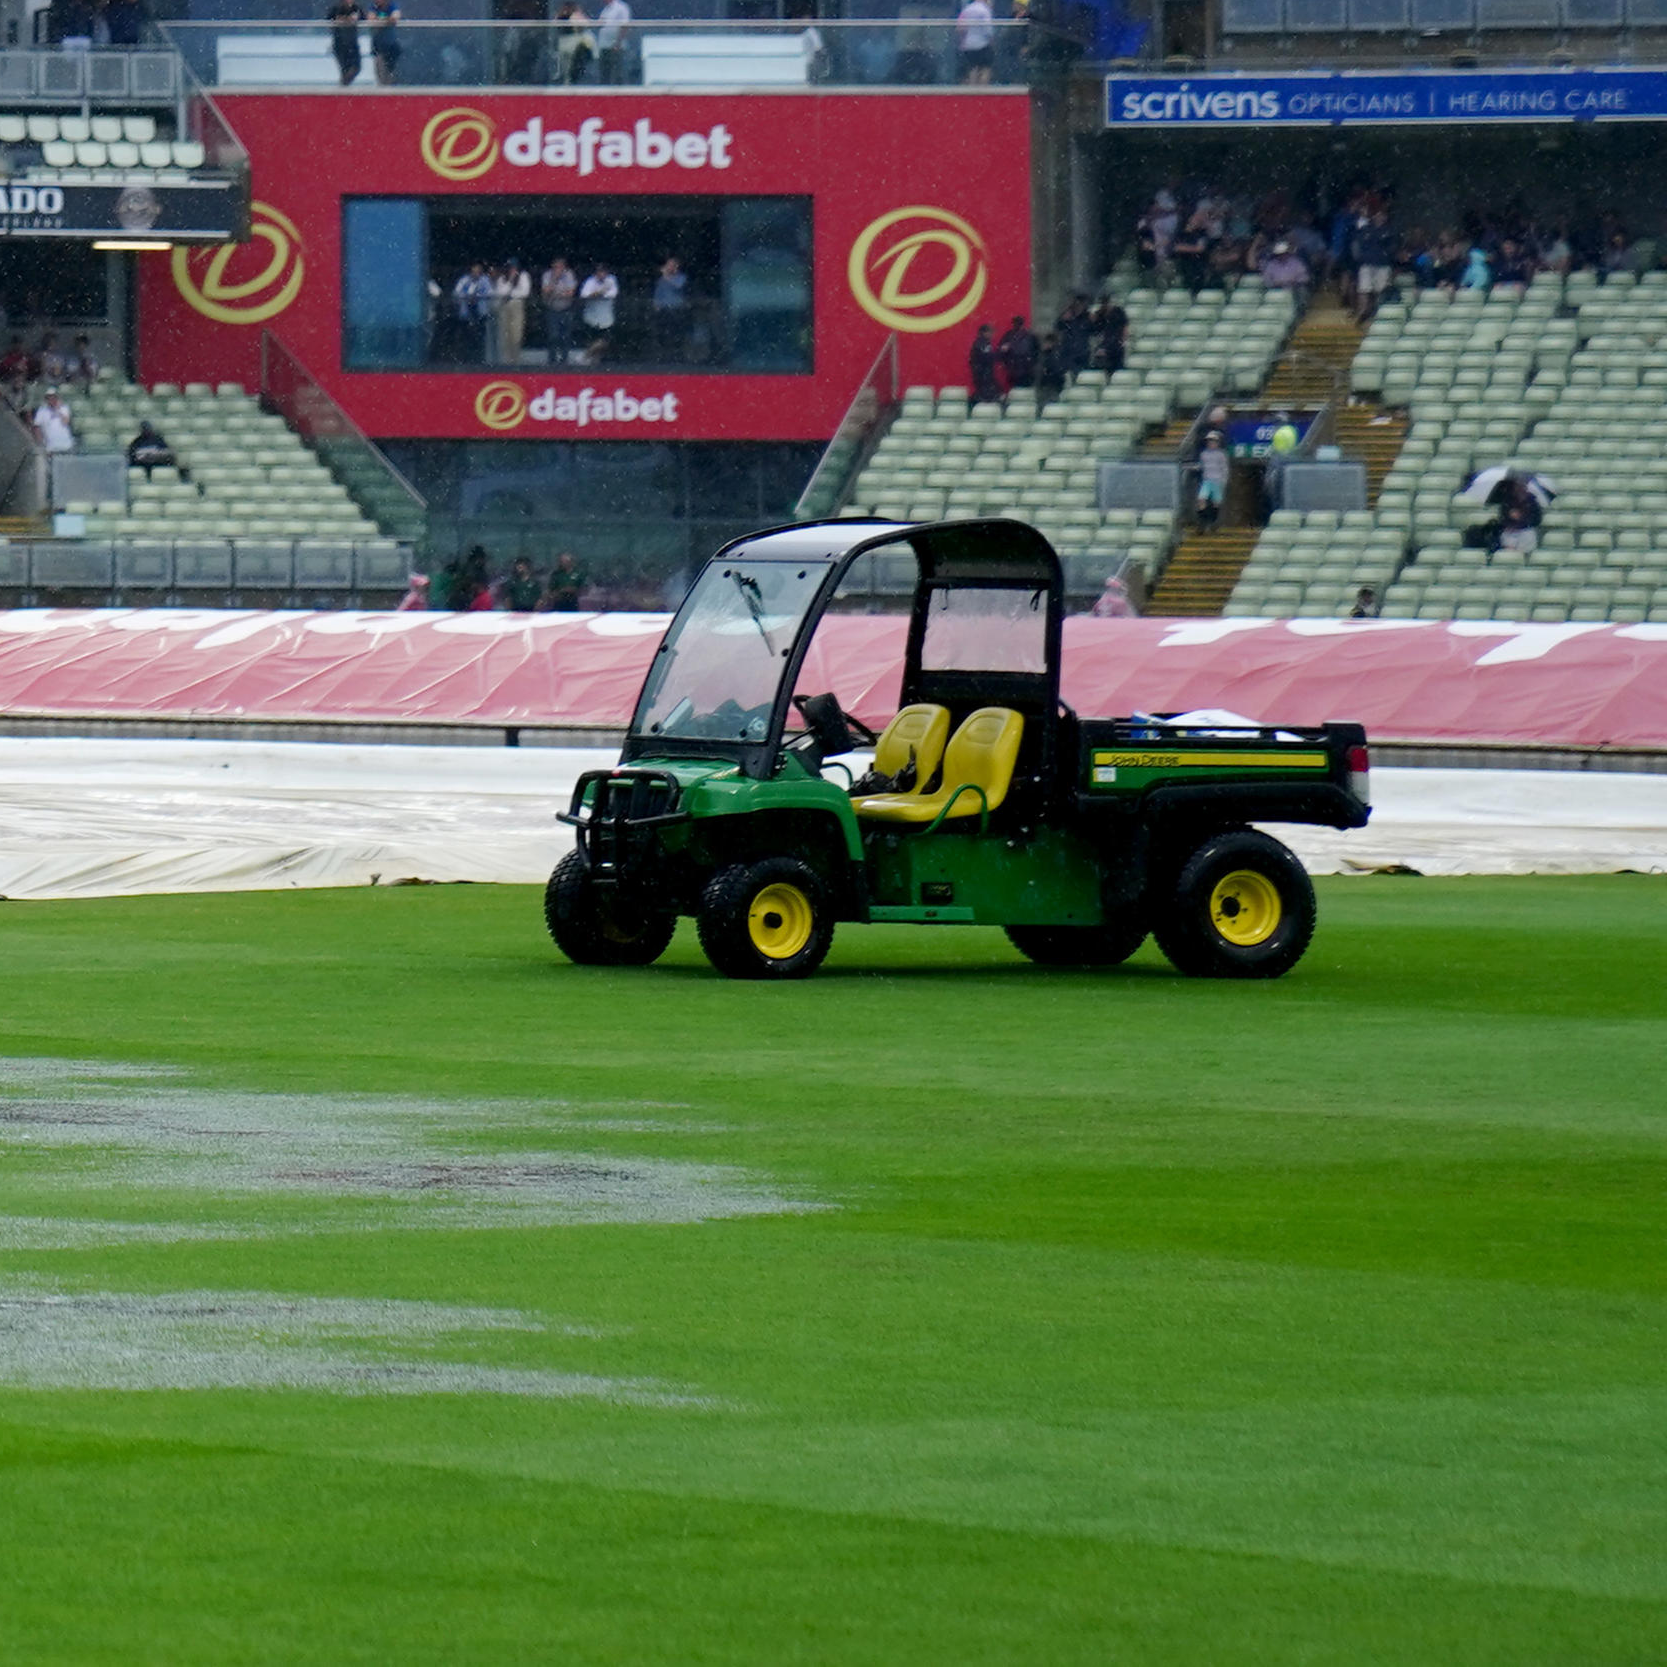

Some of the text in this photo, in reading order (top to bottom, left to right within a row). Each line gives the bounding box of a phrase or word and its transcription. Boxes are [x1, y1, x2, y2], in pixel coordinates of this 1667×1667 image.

[1122, 84, 1625, 119] scrivens OPTICIANS HEARING CARE
[503, 116, 732, 177] dafabet
[529, 387, 678, 427] dafabet
[1109, 755, 1181, 767] JOHN DEERE
